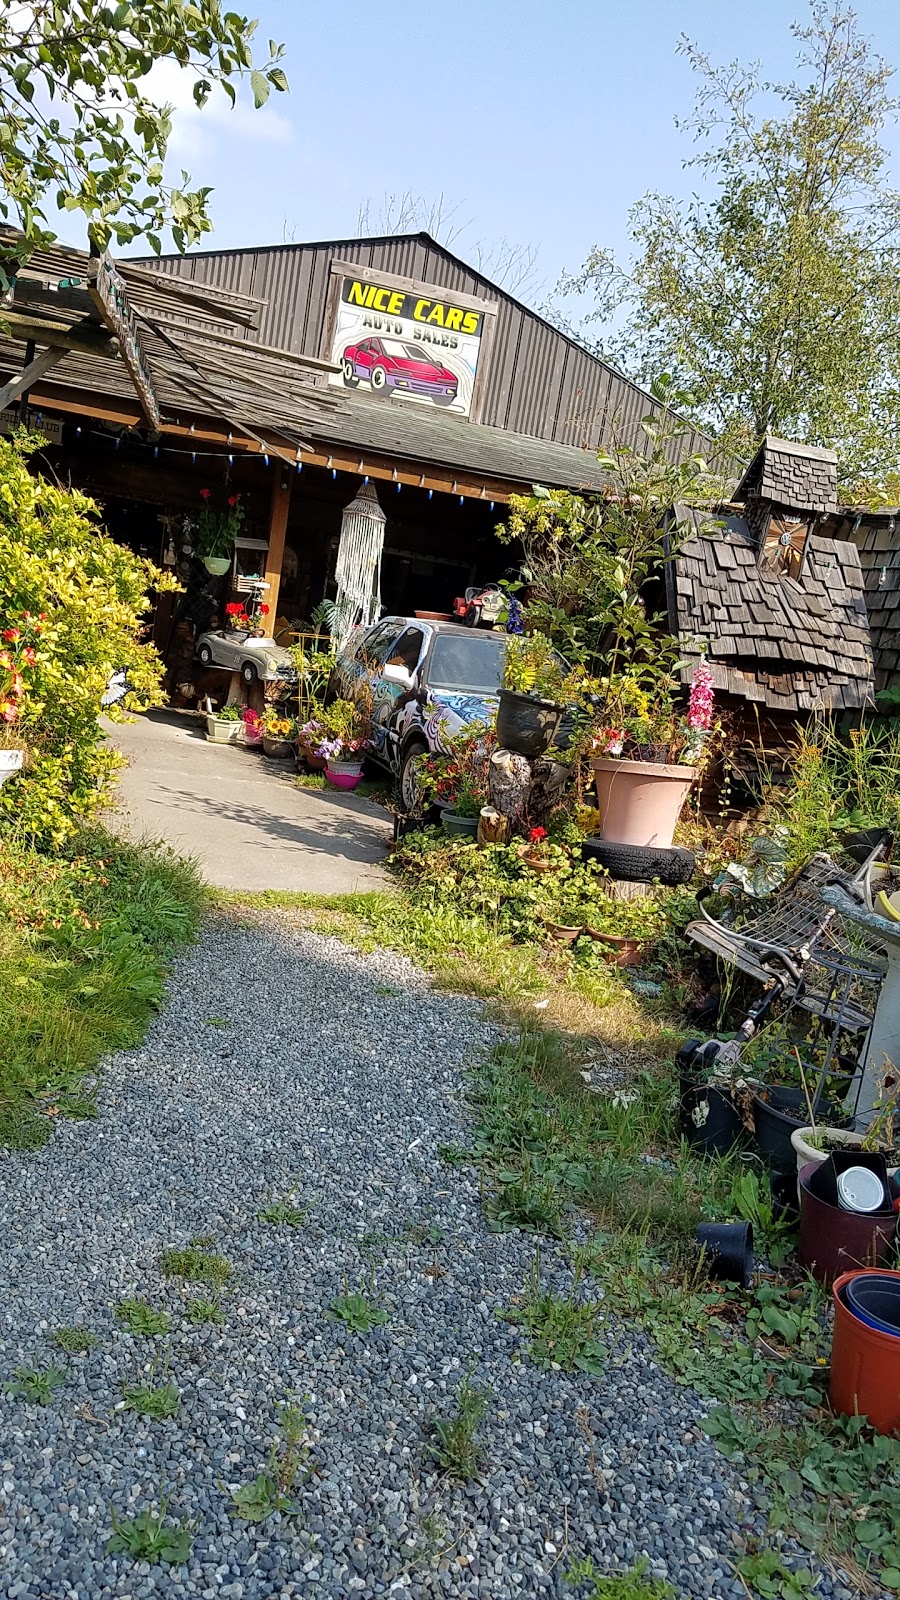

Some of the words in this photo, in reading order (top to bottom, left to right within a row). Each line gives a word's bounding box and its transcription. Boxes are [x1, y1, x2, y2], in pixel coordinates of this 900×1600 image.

[347, 281, 406, 315] NICE
[413, 299, 480, 334] CARS
[362, 313, 403, 335] AUTO
[413, 327, 459, 349] SALES
